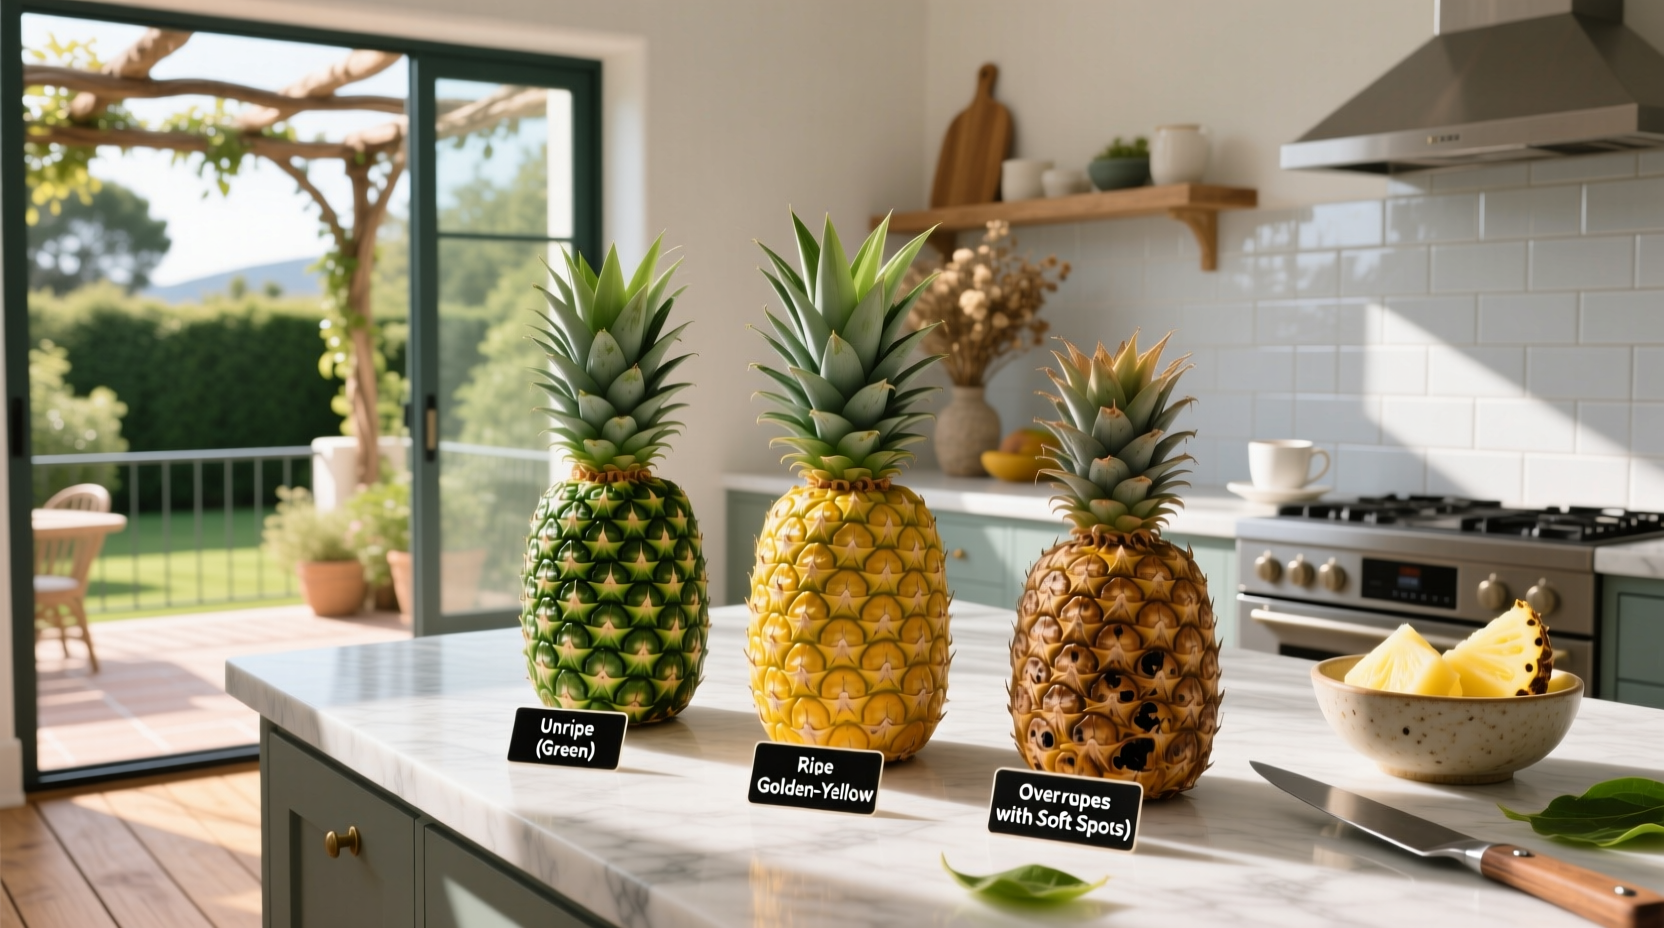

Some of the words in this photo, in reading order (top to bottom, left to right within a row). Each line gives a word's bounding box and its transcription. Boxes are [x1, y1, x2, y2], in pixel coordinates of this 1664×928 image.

[540, 717, 595, 740] Unripe
[536, 738, 595, 762] (Green)
[797, 756, 834, 775] Ripe
[757, 776, 874, 802] Golden-Yellow
[996, 805, 1033, 826] with
[1035, 809, 1073, 831] Soft
[1075, 814, 1132, 842] Spots)
